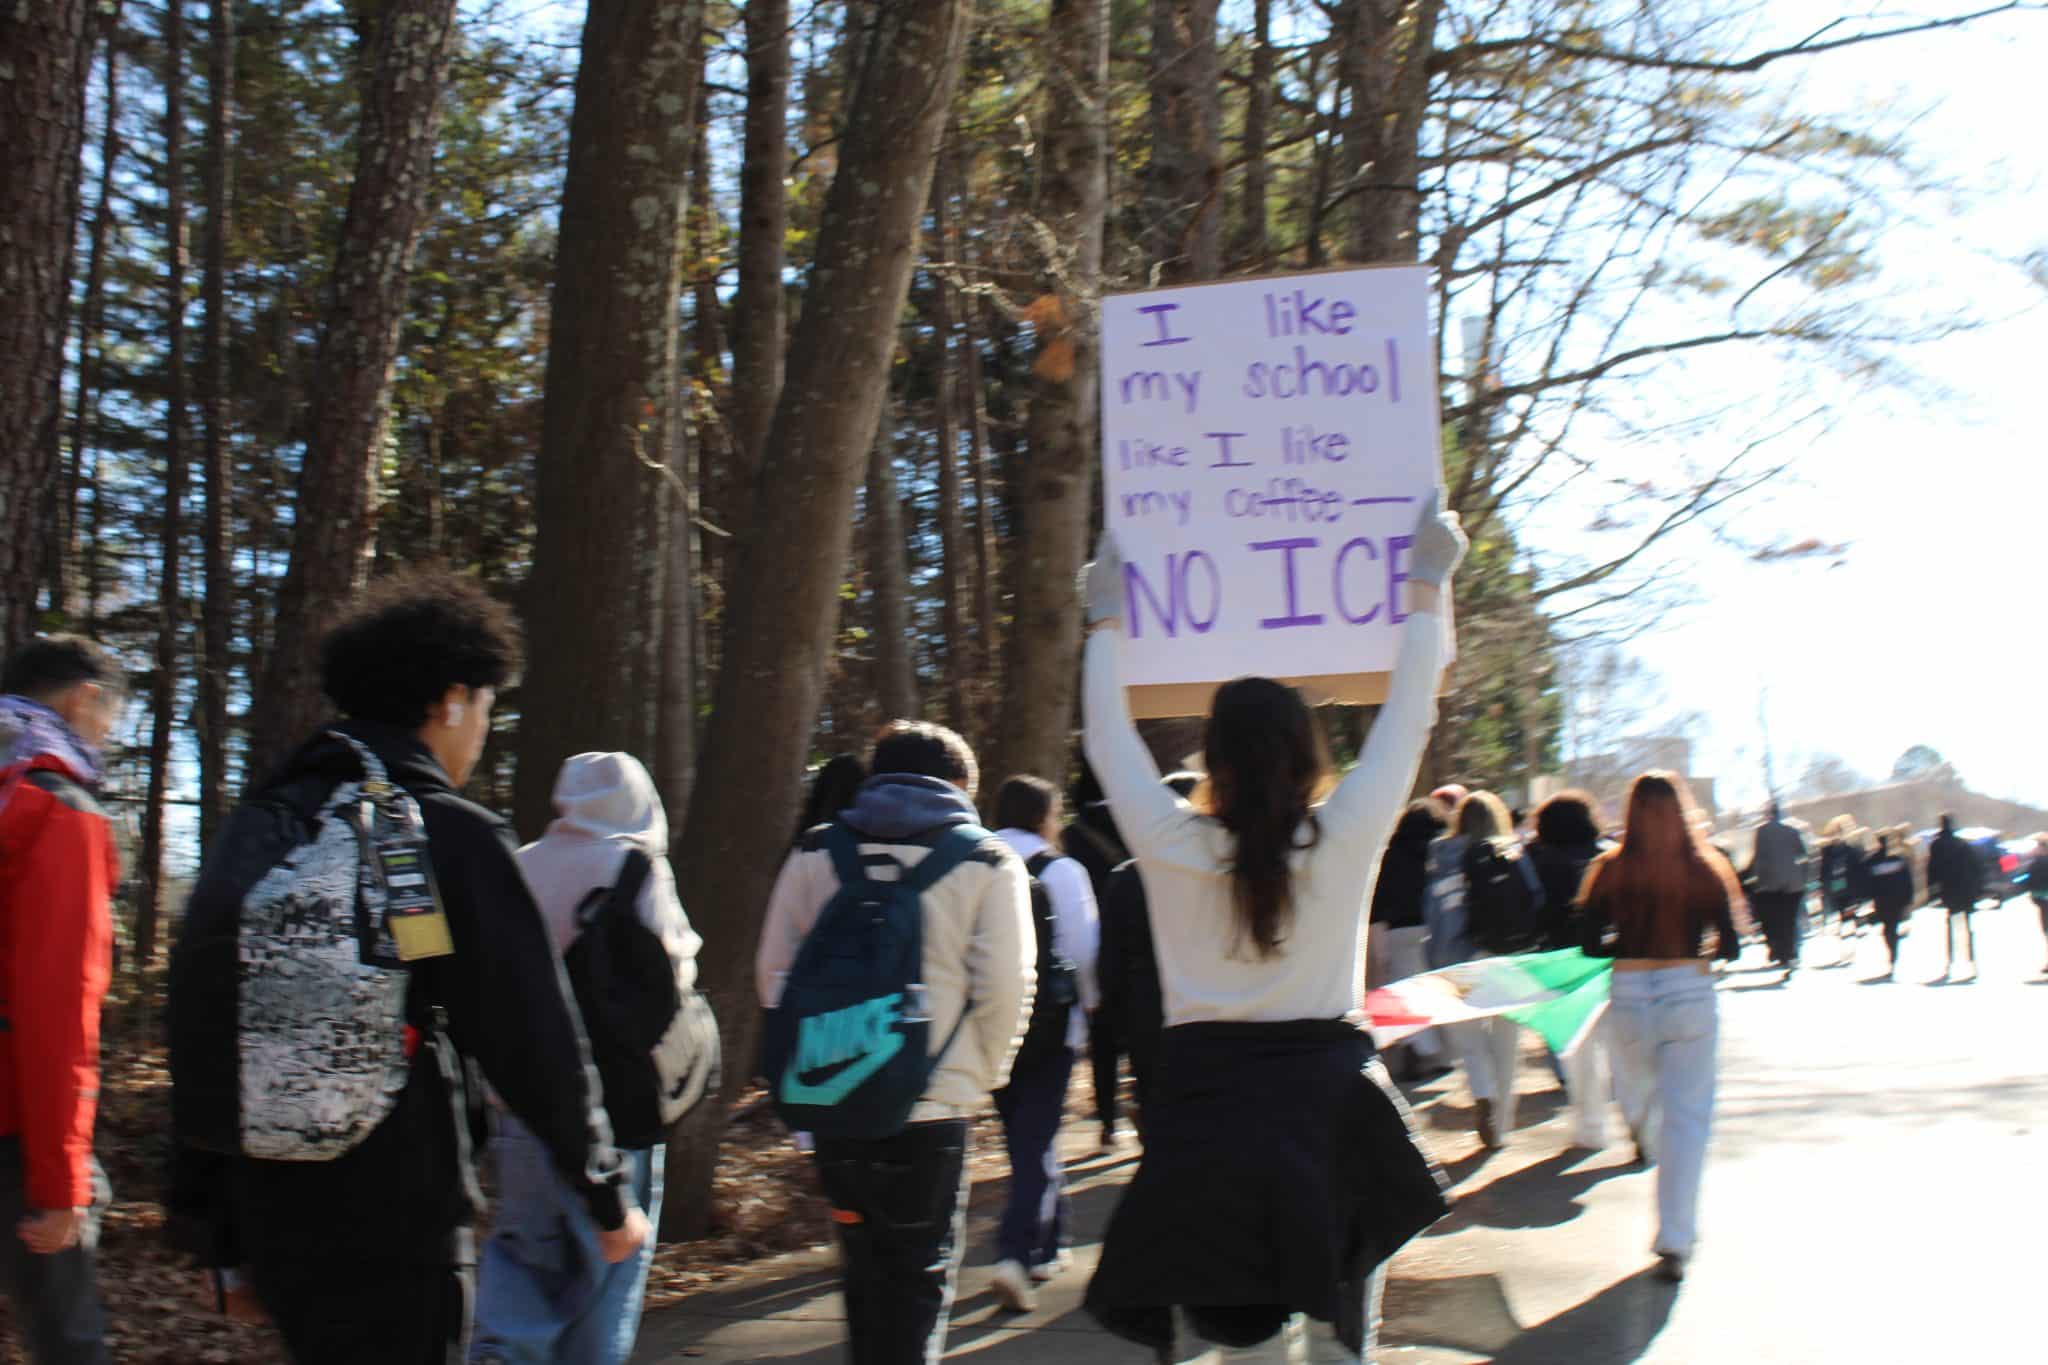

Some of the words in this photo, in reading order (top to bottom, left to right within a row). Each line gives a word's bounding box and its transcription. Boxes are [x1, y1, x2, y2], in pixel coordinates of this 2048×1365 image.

[1137, 303, 1192, 347] I
[1264, 290, 1357, 337] like
[1119, 370, 1201, 414] my
[1243, 338, 1400, 403] school
[1119, 438, 1190, 470] like
[1203, 432, 1255, 468] I
[1281, 426, 1351, 465] like
[1122, 489, 1193, 526] my
[1123, 549, 1221, 639] NO
[1248, 534, 1413, 630] ICE
